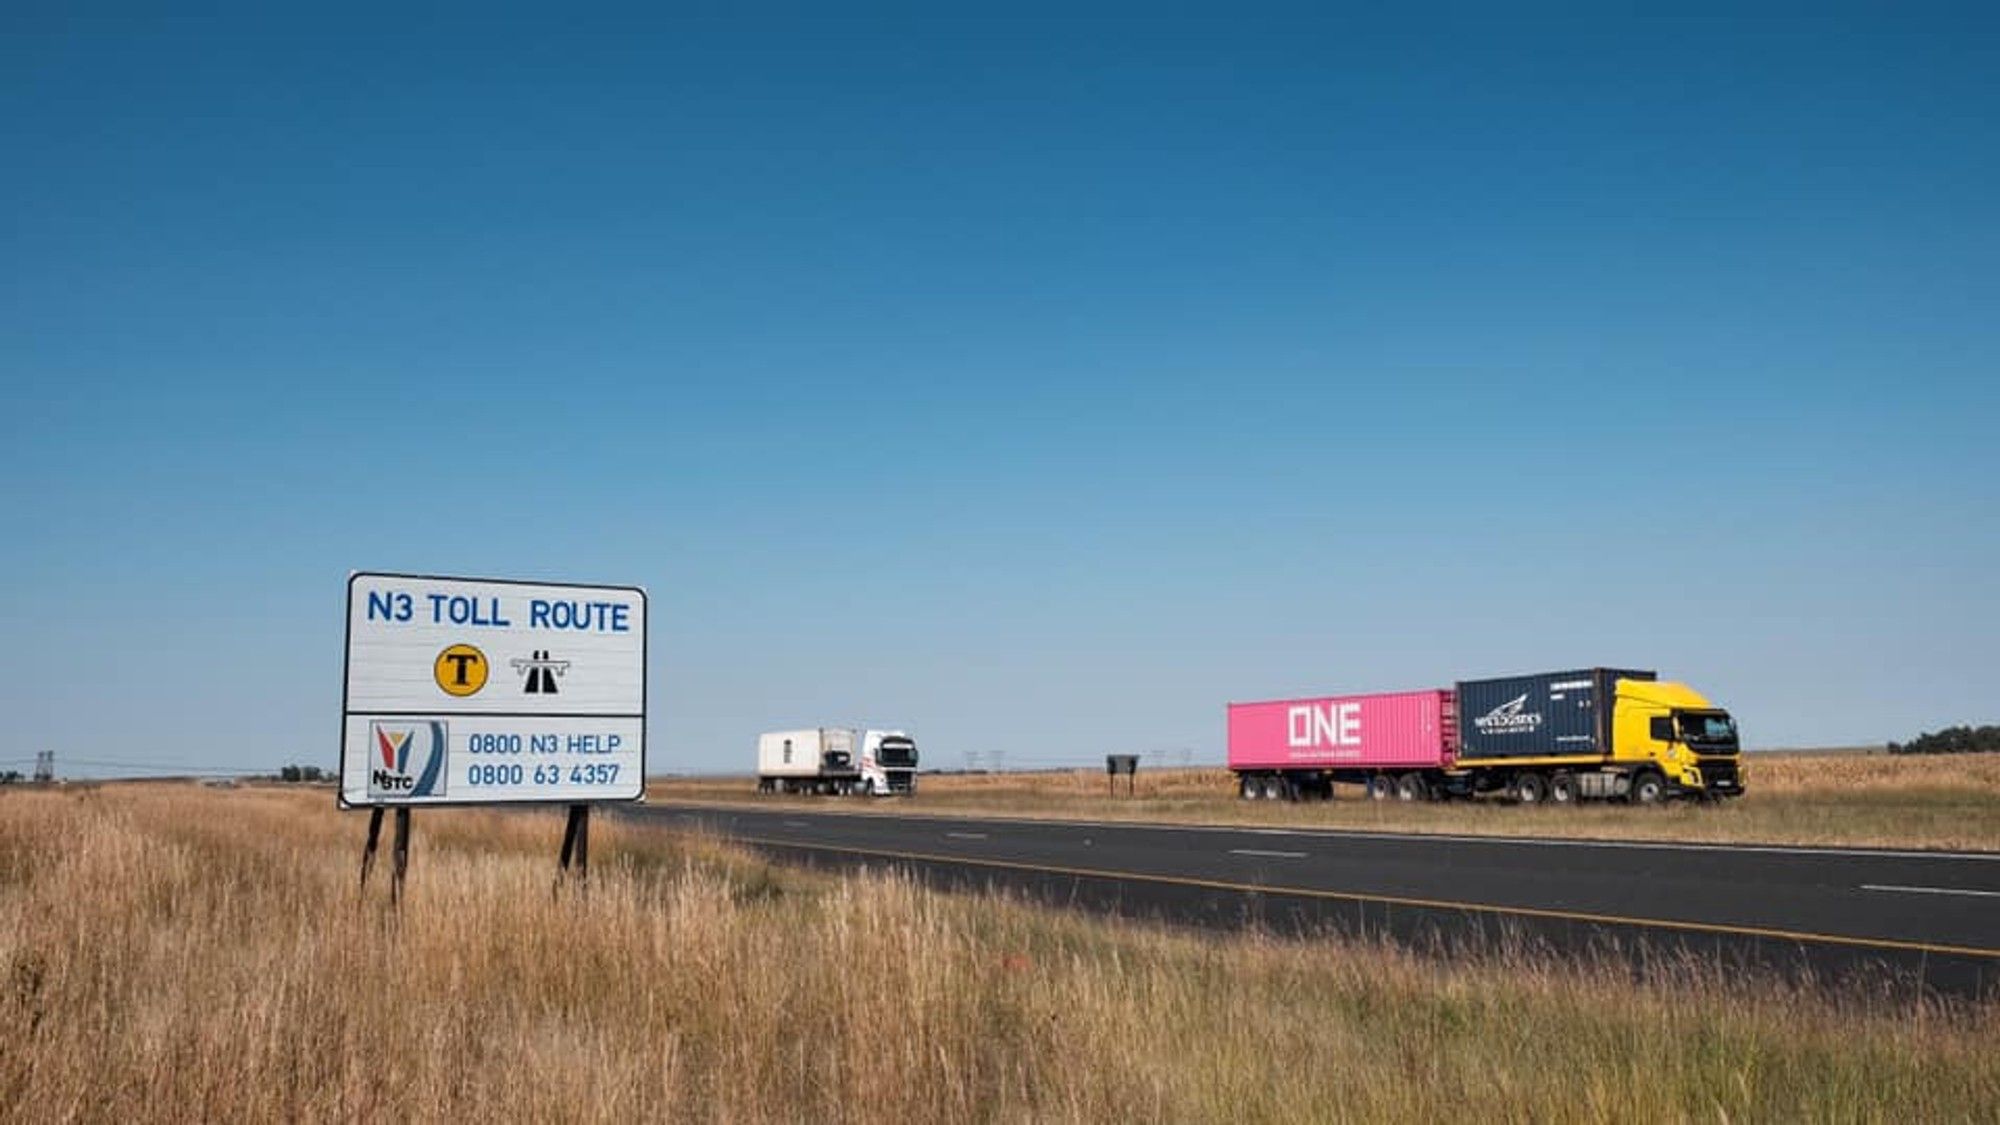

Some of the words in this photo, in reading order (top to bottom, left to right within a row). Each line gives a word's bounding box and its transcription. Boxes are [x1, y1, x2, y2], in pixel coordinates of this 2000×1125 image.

[368, 591, 414, 622] N3
[427, 594, 511, 626] TOLL
[531, 599, 630, 632] ROUTE
[446, 654, 478, 686] T
[1287, 702, 1362, 747] ONE
[469, 733, 521, 754] 0800
[531, 734, 558, 754] N3
[567, 734, 621, 754] HELP
[468, 764, 523, 785] 0800
[534, 765, 560, 784] 63
[570, 764, 619, 785] 4357
